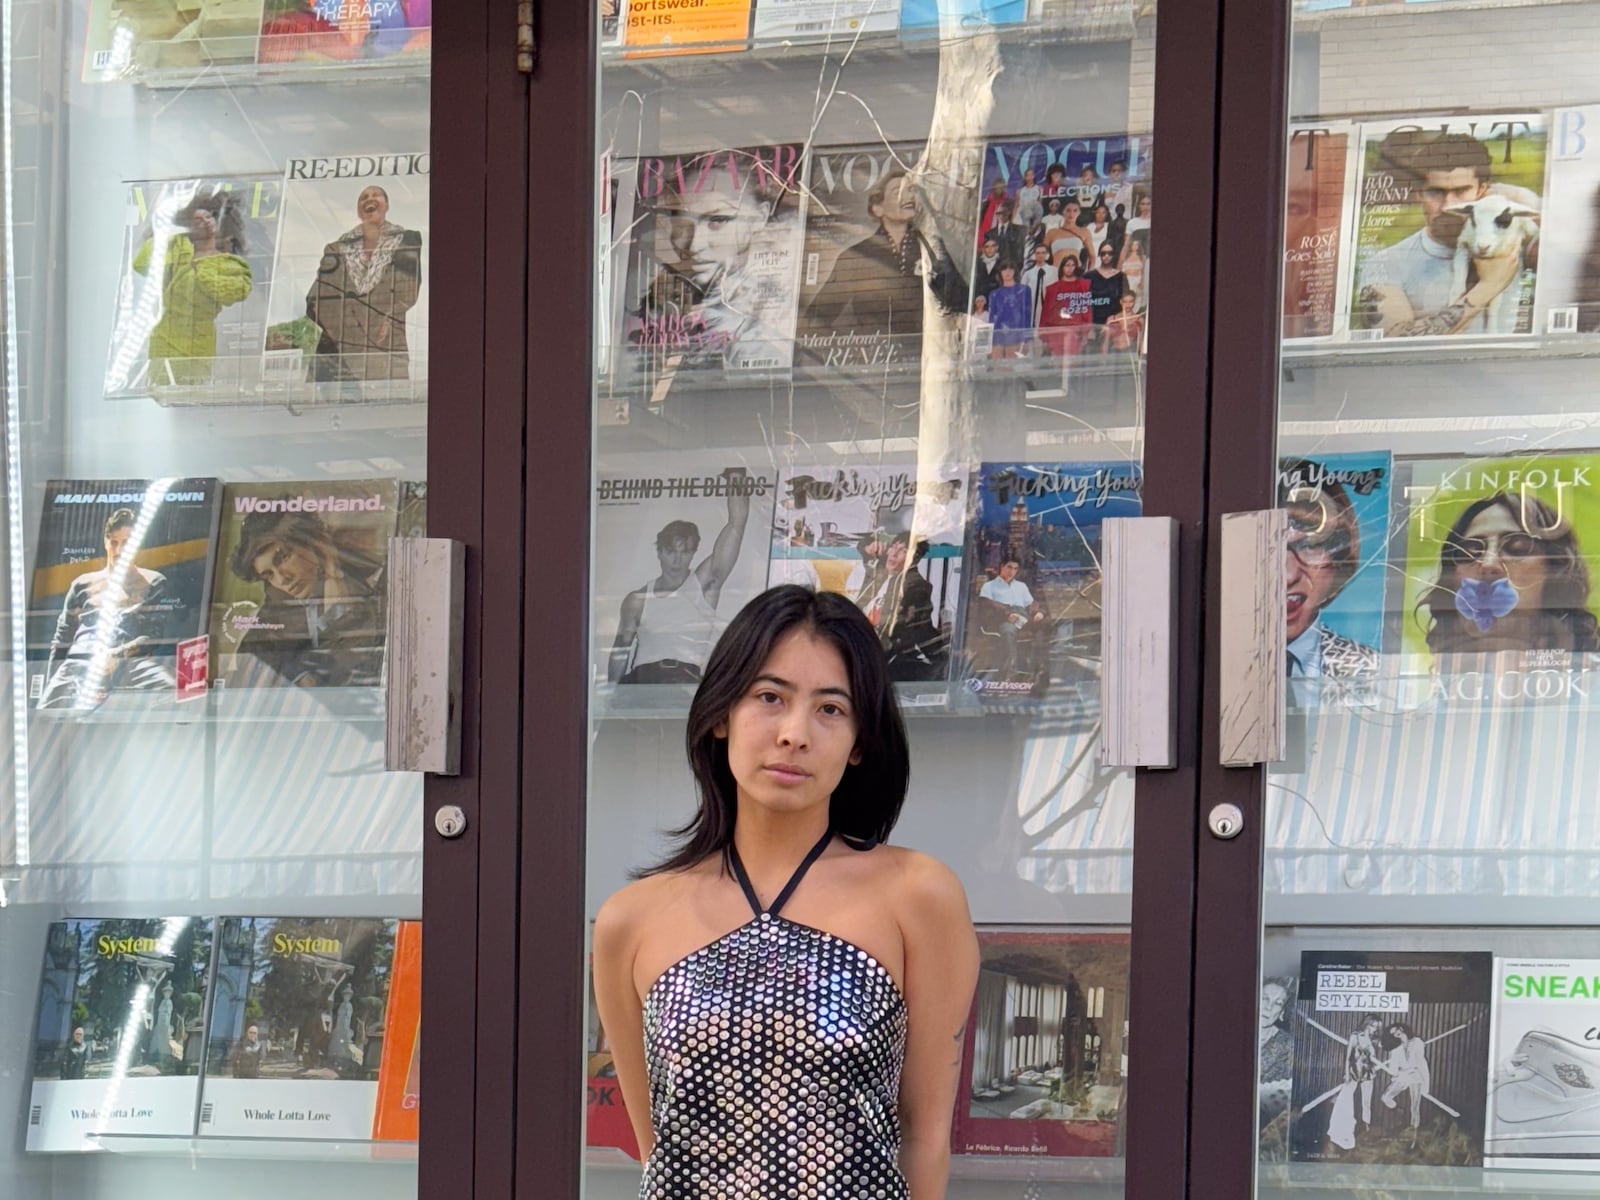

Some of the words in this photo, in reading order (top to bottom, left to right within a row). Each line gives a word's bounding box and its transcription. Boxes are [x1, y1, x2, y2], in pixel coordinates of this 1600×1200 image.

[314, 1, 396, 21] THERAPY
[642, 144, 797, 199] BAZAAR
[1365, 175, 1393, 190] BAD
[1022, 182, 1121, 200] LLECTIONS
[1365, 187, 1412, 202] BUNNY
[1363, 203, 1400, 214] Comes
[1361, 215, 1396, 227] Home
[1285, 249, 1311, 262] Goes
[1314, 247, 1335, 259] Solo
[1056, 291, 1092, 301] SPRING
[1069, 298, 1110, 307] SUMMER
[836, 329, 881, 346] about
[1441, 467, 1591, 490] KINFOLK
[600, 479, 663, 500] BEHIND
[668, 478, 700, 498] THE
[703, 476, 767, 498] BLINDS
[54, 493, 96, 504] MAN
[96, 492, 154, 503] ABOU
[155, 491, 205, 502] OWN
[234, 494, 385, 513] Wonderland.
[232, 615, 259, 624] Mark
[985, 681, 1034, 690] TELEVISION
[1432, 671, 1489, 701] A.G.
[1497, 669, 1591, 700] COOK
[273, 933, 340, 955] System
[1319, 974, 1382, 988] REBEL
[1318, 994, 1402, 1009] STYLIST
[99, 1109, 128, 1119] otta
[131, 1108, 153, 1118] Love
[244, 1109, 276, 1121] Whole
[278, 1109, 304, 1121] Lotta
[307, 1109, 331, 1121] Love
